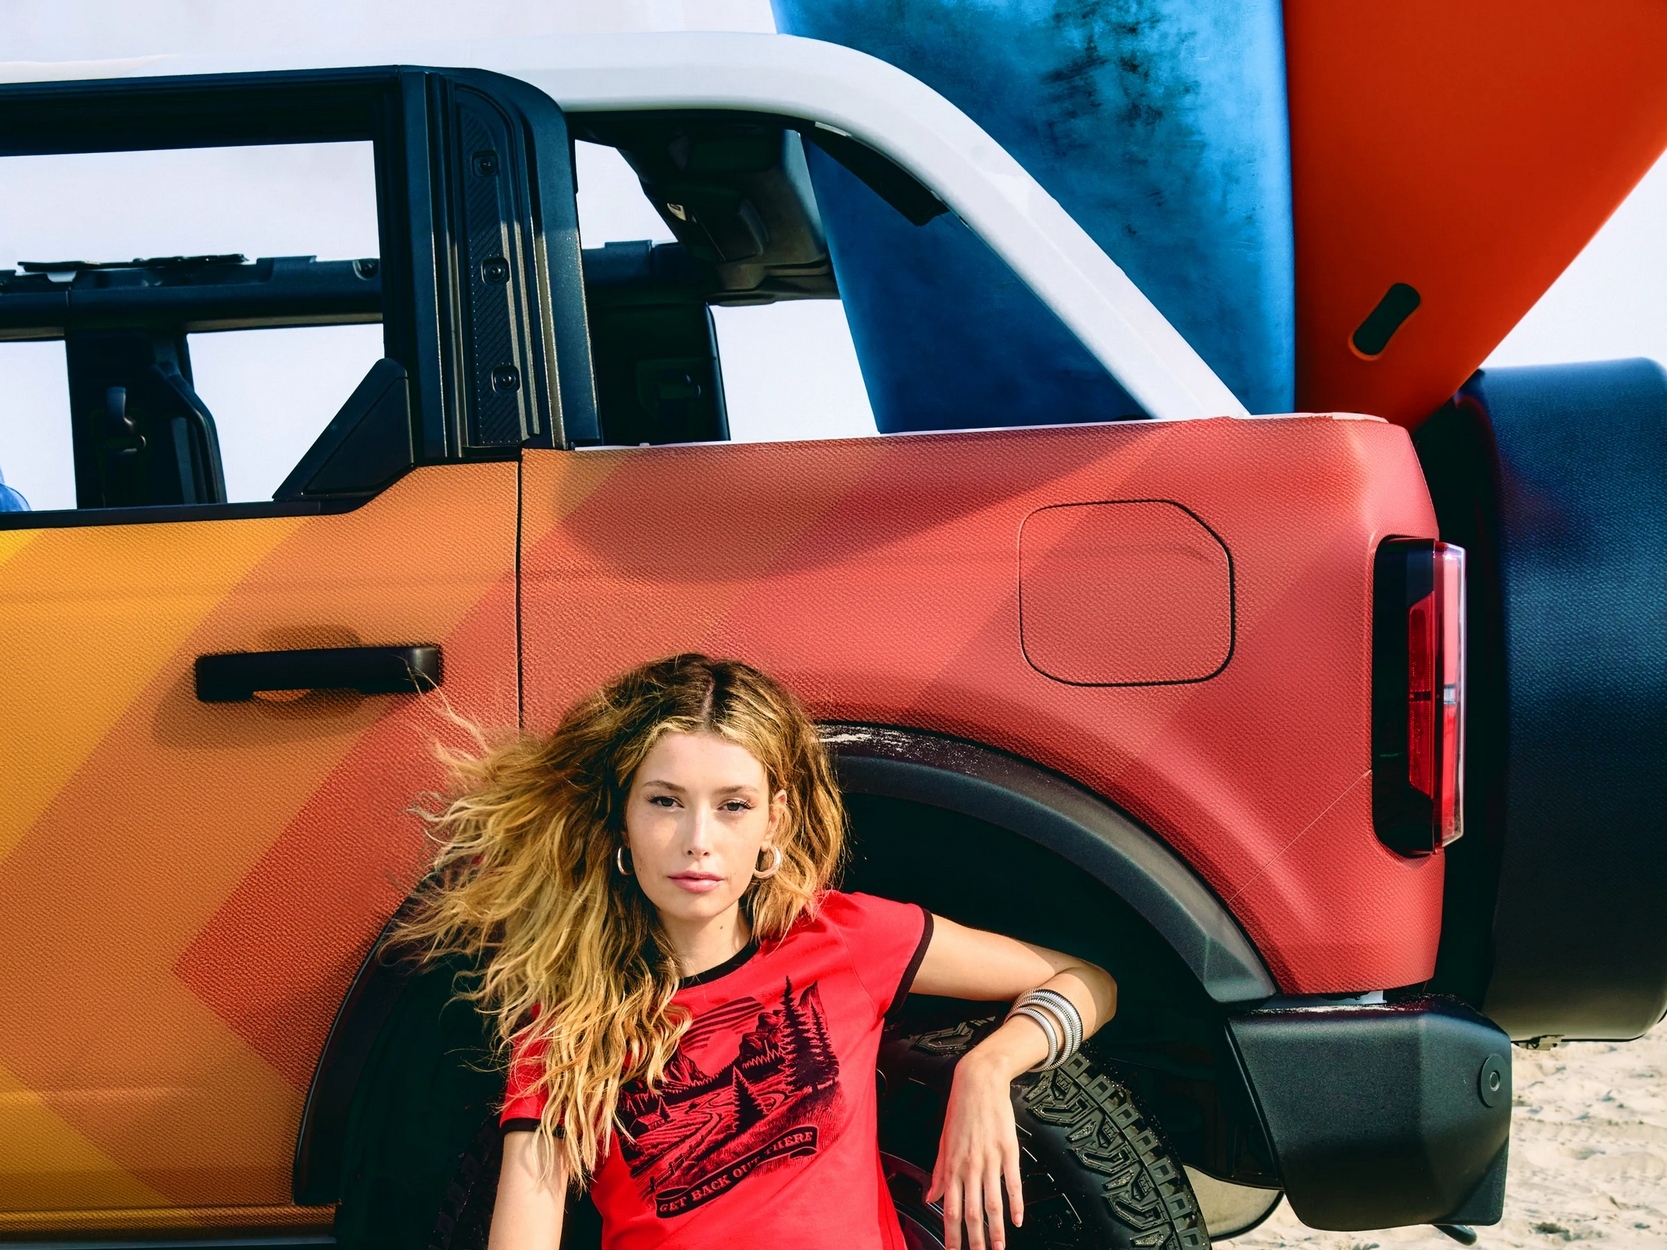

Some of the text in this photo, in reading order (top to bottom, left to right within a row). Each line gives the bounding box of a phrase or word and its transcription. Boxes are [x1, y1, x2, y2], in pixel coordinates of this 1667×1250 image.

[659, 1131, 813, 1213] GET BACK OUT THERE
